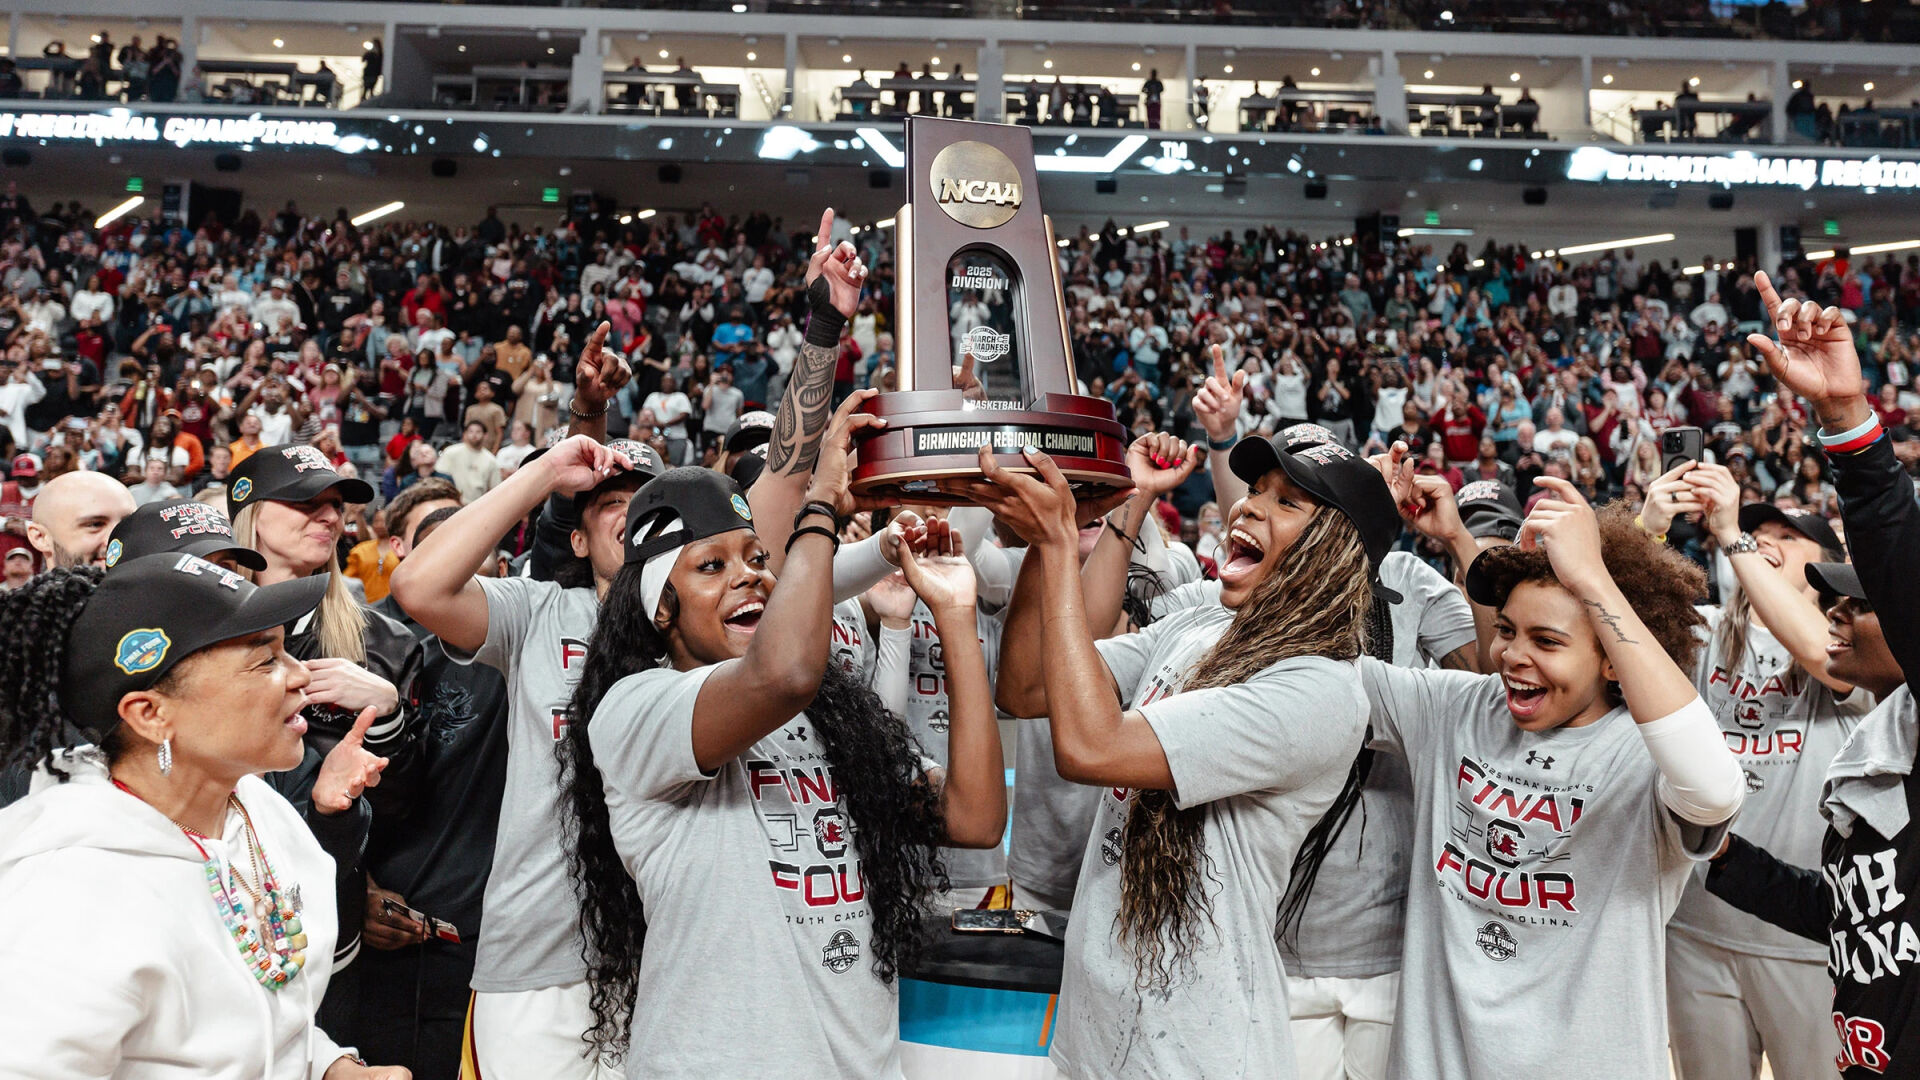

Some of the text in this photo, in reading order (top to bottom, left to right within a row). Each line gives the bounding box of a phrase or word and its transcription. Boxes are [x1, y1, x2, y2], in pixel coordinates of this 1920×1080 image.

[1822, 160, 1920, 188] REGIO
[940, 178, 1022, 208] NCAA
[966, 266, 992, 276] 2025
[952, 276, 1001, 290] DIVISION
[970, 334, 997, 343] MARCH
[974, 343, 1009, 352] MADNESS
[968, 400, 1023, 411] BASKETBALL
[918, 431, 1094, 453] BIRMINGHAM REGIONAL CHAMPION
[170, 524, 232, 540] FOUR
[1722, 729, 1803, 755] OUR
[1507, 775, 1537, 789] NCAA
[768, 858, 865, 908] FOU
[1434, 841, 1580, 914] FOUR
[1477, 932, 1517, 953] FINAL FOUR
[824, 945, 859, 961] FINAL FOUR
